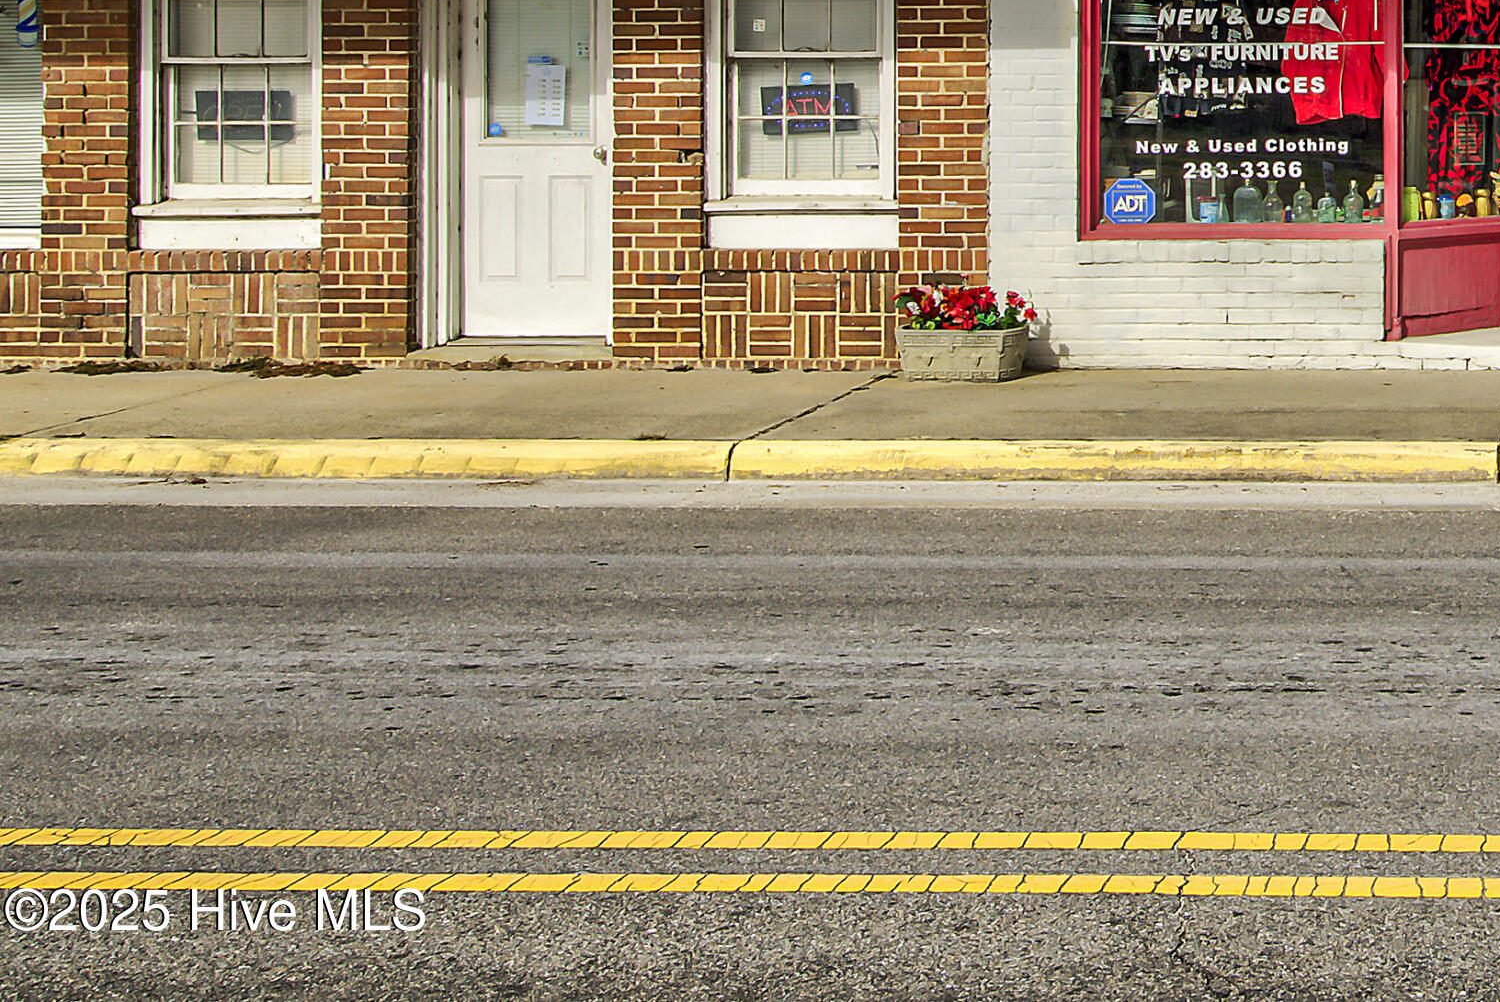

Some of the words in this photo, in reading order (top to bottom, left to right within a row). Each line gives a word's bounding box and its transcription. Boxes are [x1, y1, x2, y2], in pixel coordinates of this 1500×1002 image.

[1158, 7, 1217, 26] NEW
[1226, 8, 1244, 25] &
[1255, 7, 1327, 26] USED
[1144, 44, 1192, 62] TV's
[1211, 44, 1339, 61] FURNITURE
[1158, 77, 1326, 95] APPLIANCES
[786, 98, 832, 117] ATM
[1136, 140, 1178, 155] New
[1187, 141, 1200, 153] &
[1208, 139, 1257, 153] Used
[1265, 138, 1349, 155] Clothing
[1183, 162, 1302, 178] 283-3366
[1113, 194, 1148, 213] ADT
